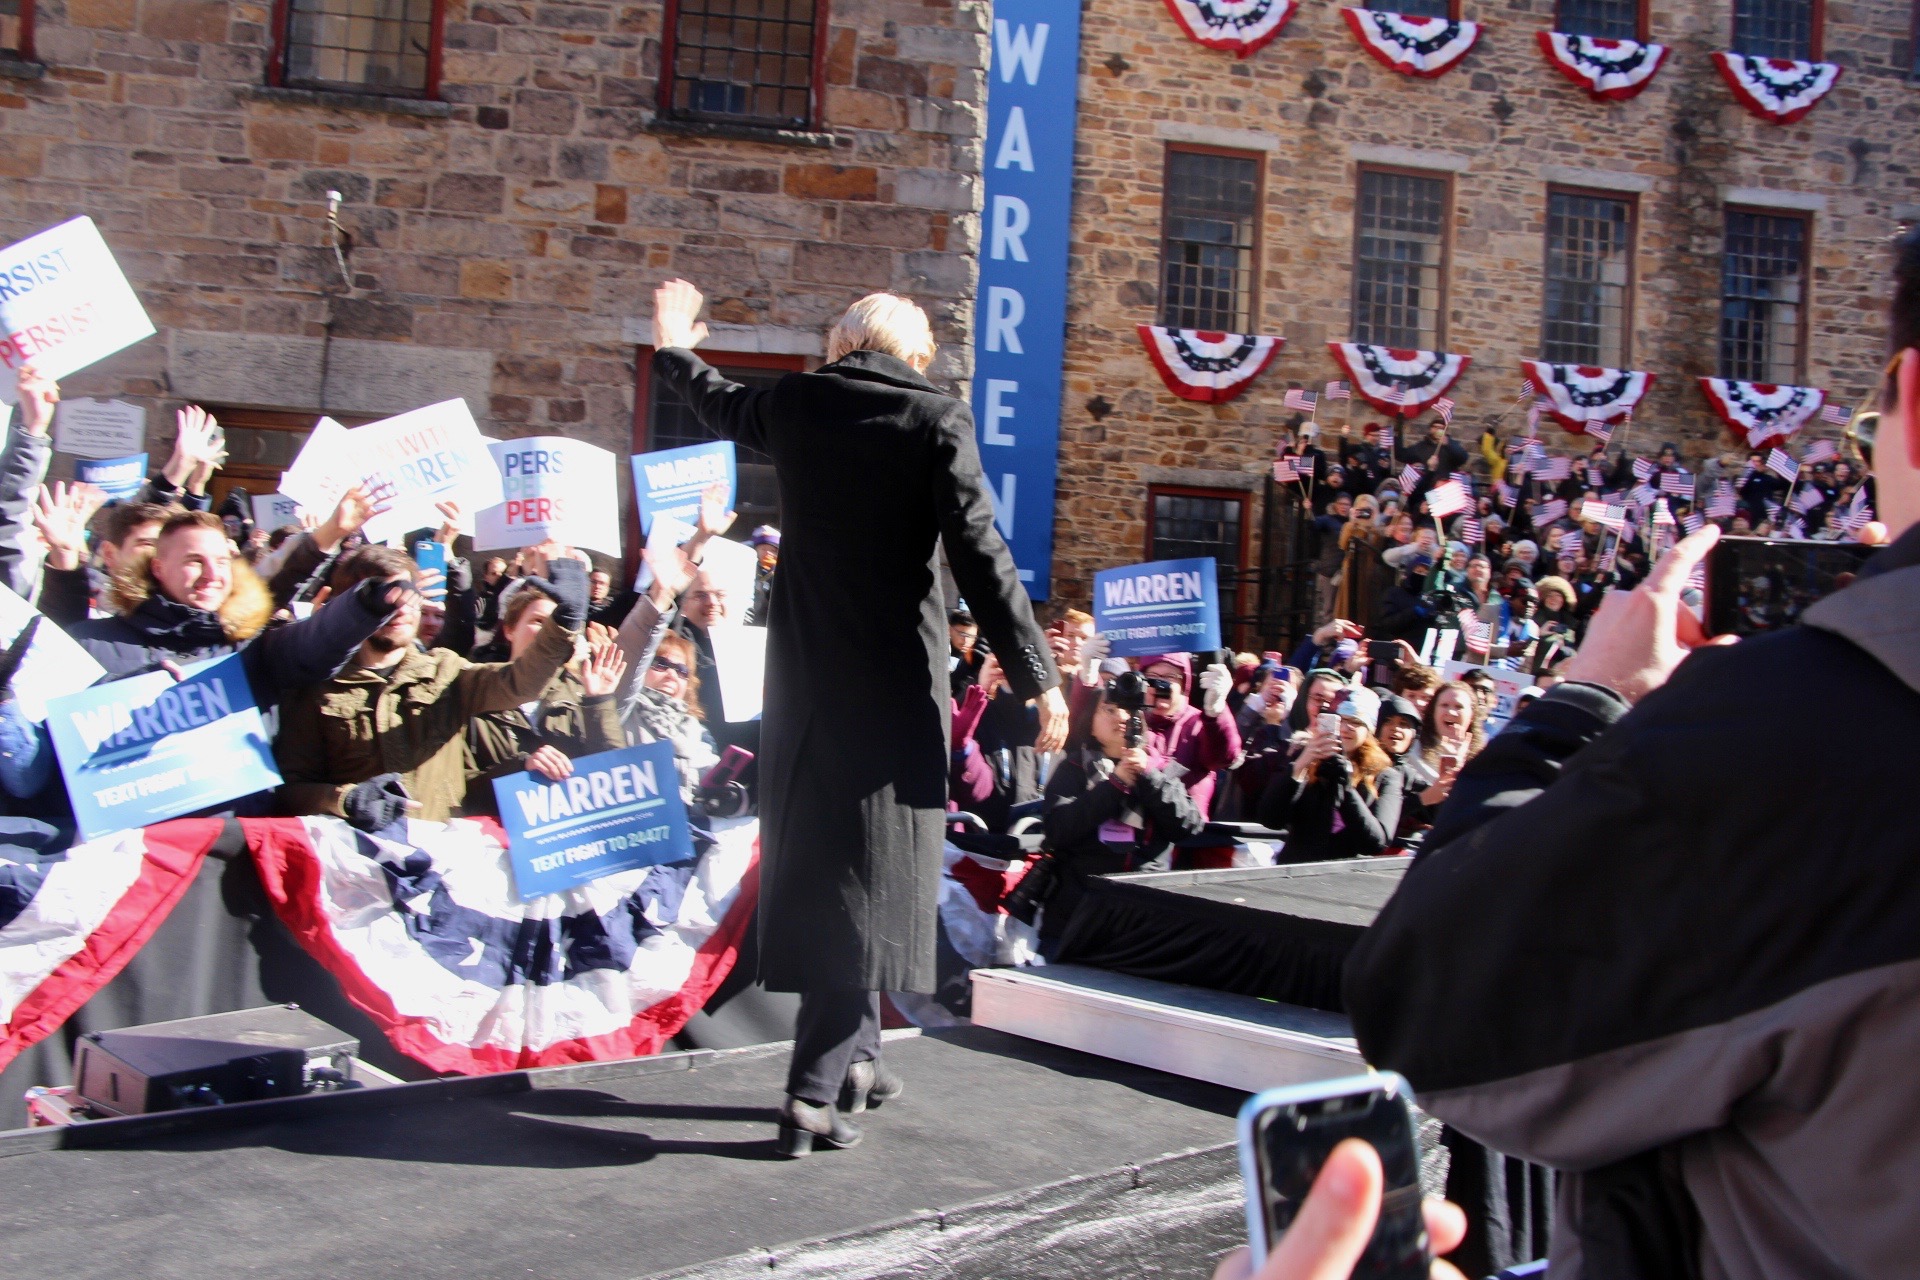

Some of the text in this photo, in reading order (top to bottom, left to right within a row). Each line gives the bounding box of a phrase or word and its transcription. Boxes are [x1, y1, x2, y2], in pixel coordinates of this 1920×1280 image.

[982, 18, 1050, 540] WARREN
[643, 453, 727, 491] WARREN
[1103, 571, 1202, 607] WARREN
[1127, 626, 1158, 640] FIGHT
[1157, 625, 1173, 637] TO
[69, 677, 232, 754] WARREN
[93, 783, 137, 809] TEXT
[515, 760, 659, 827] WARREN
[529, 851, 565, 873] TEXT
[564, 840, 607, 864] FIGHT
[606, 835, 628, 852] TO
[627, 825, 670, 848] 24477
